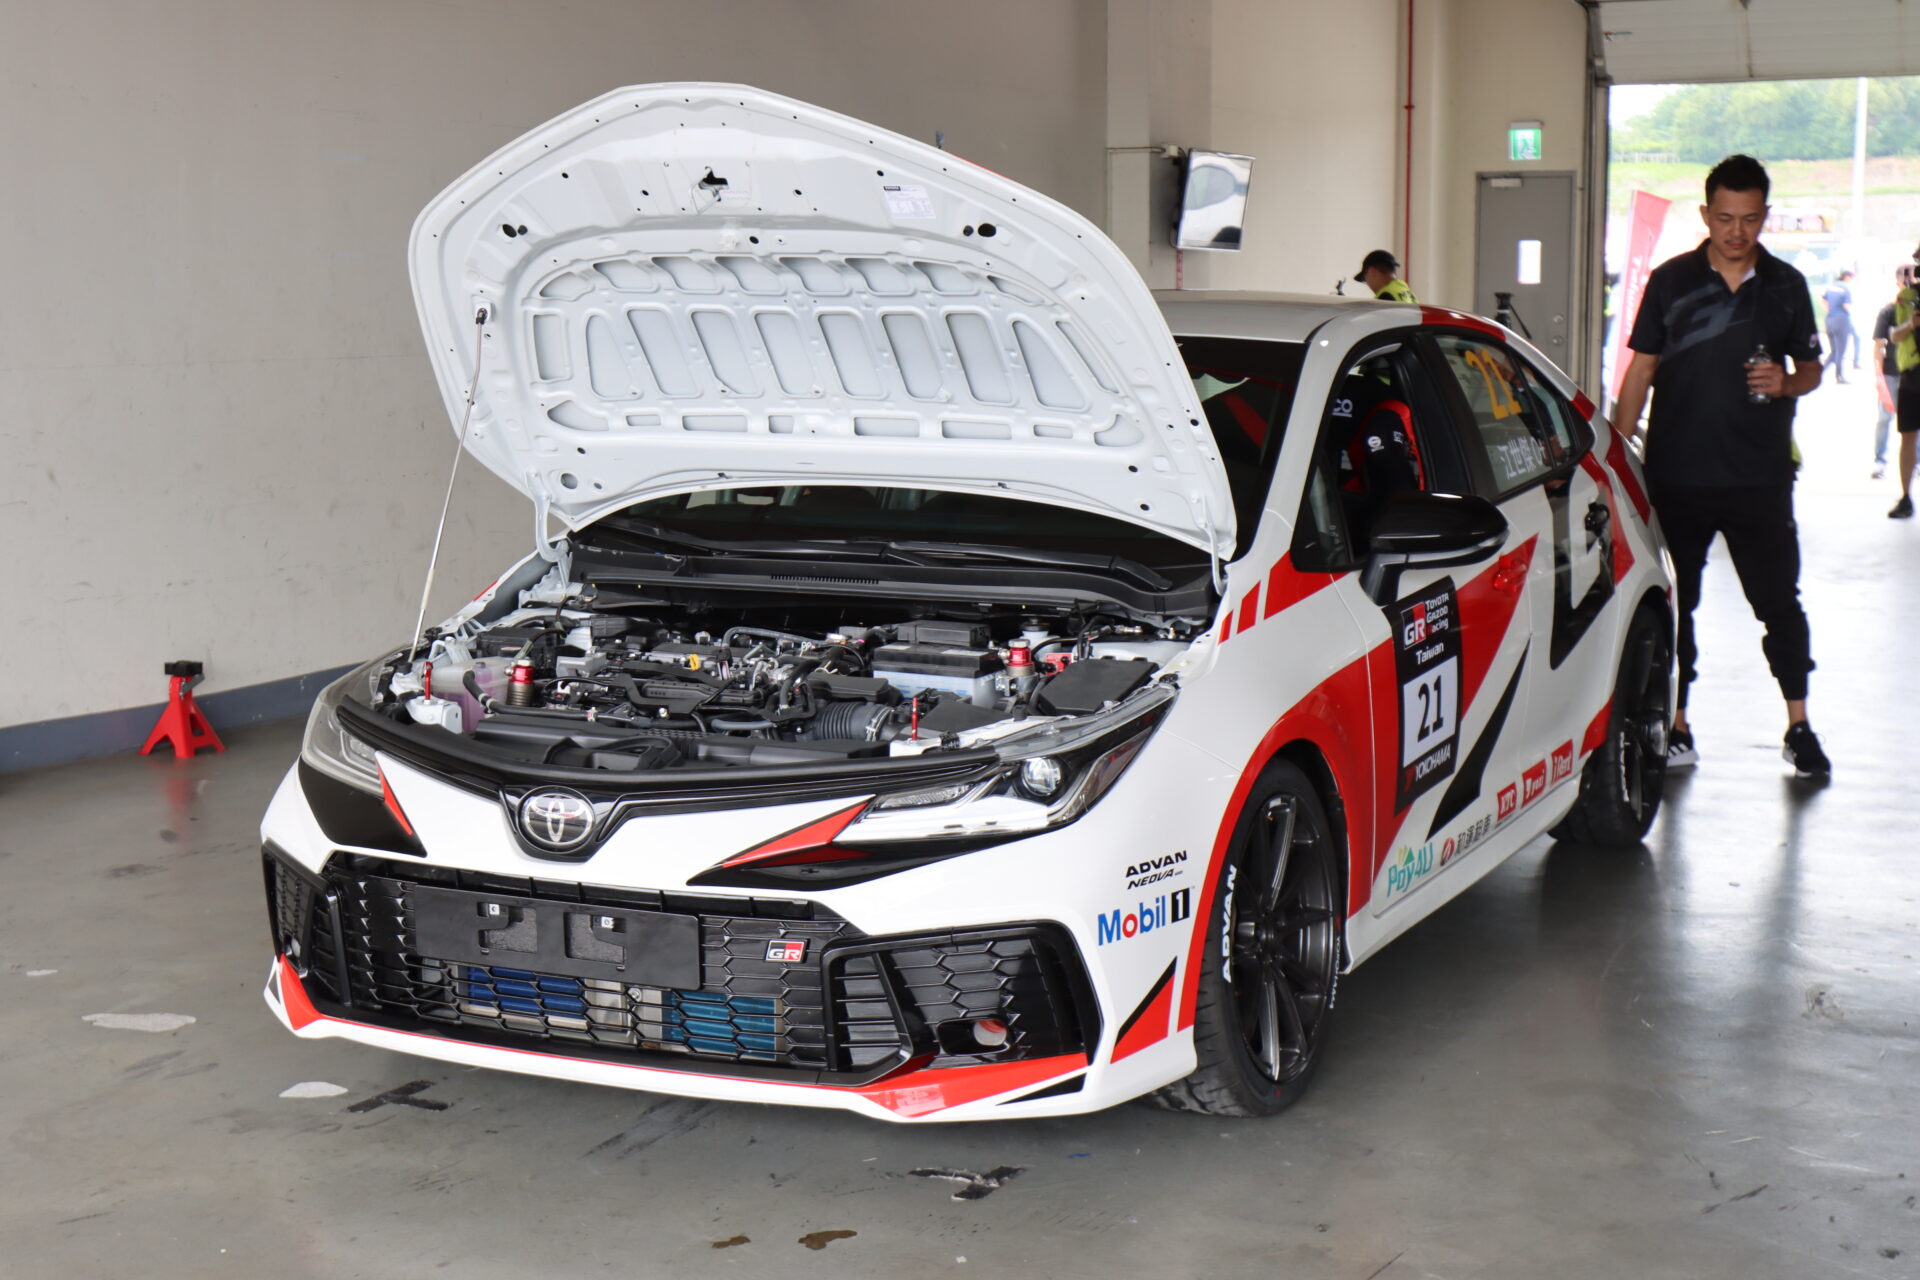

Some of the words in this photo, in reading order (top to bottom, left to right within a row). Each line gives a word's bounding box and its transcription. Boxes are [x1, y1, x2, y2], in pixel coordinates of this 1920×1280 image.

[1425, 592, 1449, 611] TOYOTA
[1426, 605, 1448, 623] GAZOO
[1403, 618, 1425, 646] GR
[1415, 643, 1444, 665] Taiwan
[1417, 674, 1444, 743] 21
[1415, 743, 1450, 782] YOKOHAMA
[1126, 850, 1187, 877] ADVAN
[1127, 868, 1174, 889] NEOVA
[1097, 895, 1166, 946] Mobil
[1222, 864, 1237, 983] ADVAN
[768, 948, 801, 960] GR
